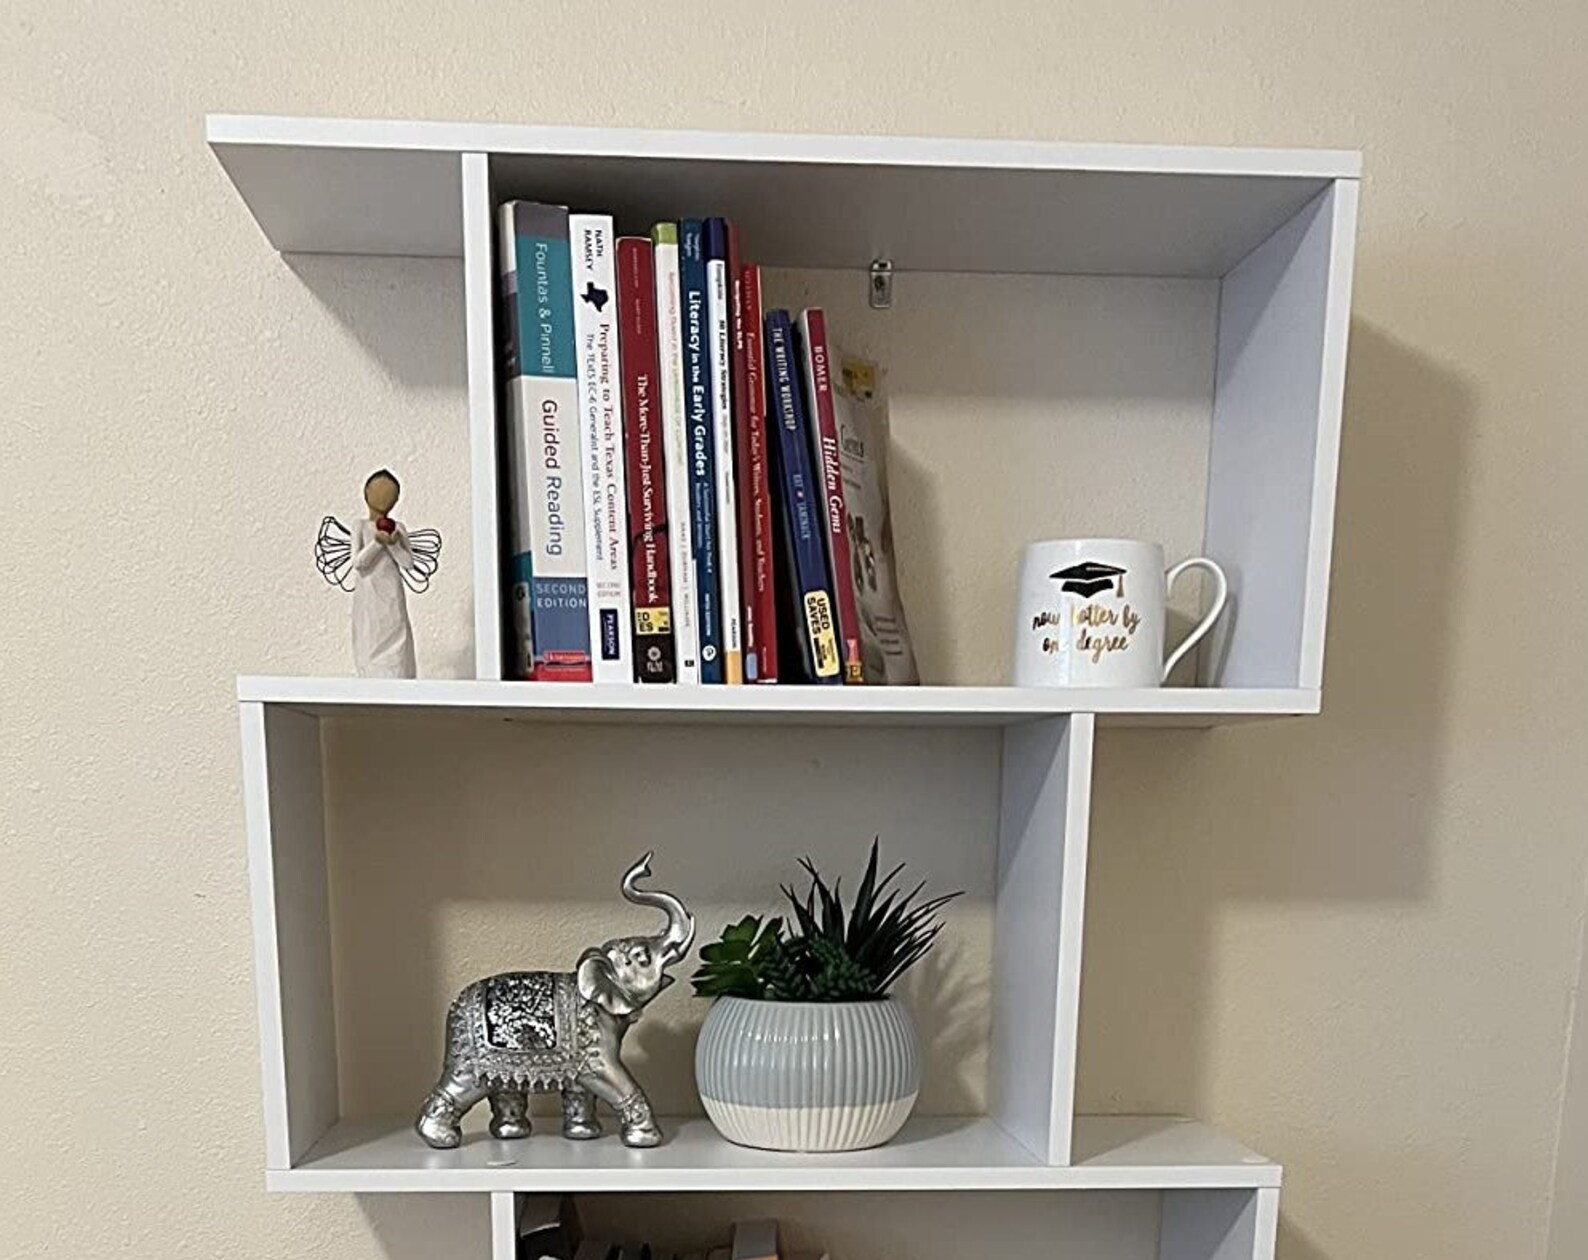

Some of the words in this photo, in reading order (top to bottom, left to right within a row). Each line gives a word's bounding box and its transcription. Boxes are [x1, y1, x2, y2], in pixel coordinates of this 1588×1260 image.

[584, 229, 595, 271] RAMSEY
[594, 229, 604, 257] NATH
[535, 242, 552, 303] Fountas
[539, 308, 551, 319] &
[687, 290, 701, 350] Literacy
[540, 323, 554, 373] Pinnell
[586, 333, 596, 344] The
[599, 323, 611, 384] Preparing
[718, 331, 727, 366] Literacy
[746, 332, 756, 370] Essential
[772, 327, 785, 344] THE
[691, 353, 700, 364] in
[691, 365, 701, 382] the
[775, 346, 790, 383] WRITING
[814, 346, 828, 392] BOMER
[602, 389, 611, 401] to
[690, 384, 706, 422] Early
[719, 369, 728, 409] Strategies
[603, 406, 614, 441] Teach
[750, 415, 759, 429] for
[781, 385, 796, 431] WORKSHOP
[542, 399, 561, 469] Guided
[589, 406, 600, 452] Generalist
[591, 453, 602, 470] and
[604, 446, 616, 478] Texas
[694, 424, 708, 476] Grades
[823, 437, 840, 490] Hidden
[592, 473, 602, 487] the
[593, 490, 602, 506] ESL
[637, 374, 649, 397] The
[645, 544, 658, 603] Handbook
[546, 476, 564, 556] Reading
[606, 483, 618, 532] Content
[829, 495, 843, 533] Gems
[593, 508, 604, 561] Supplement
[756, 540, 765, 556] and
[609, 536, 619, 570] Areas
[536, 583, 586, 595] SECOND
[757, 557, 766, 592] Teachers
[537, 597, 587, 608] EDITION
[807, 597, 821, 635] SAVES
[817, 597, 830, 630] USED
[1032, 611, 1060, 630] now
[1122, 604, 1141, 635] by
[607, 613, 615, 655] PEARSON
[1076, 628, 1131, 664] degree
